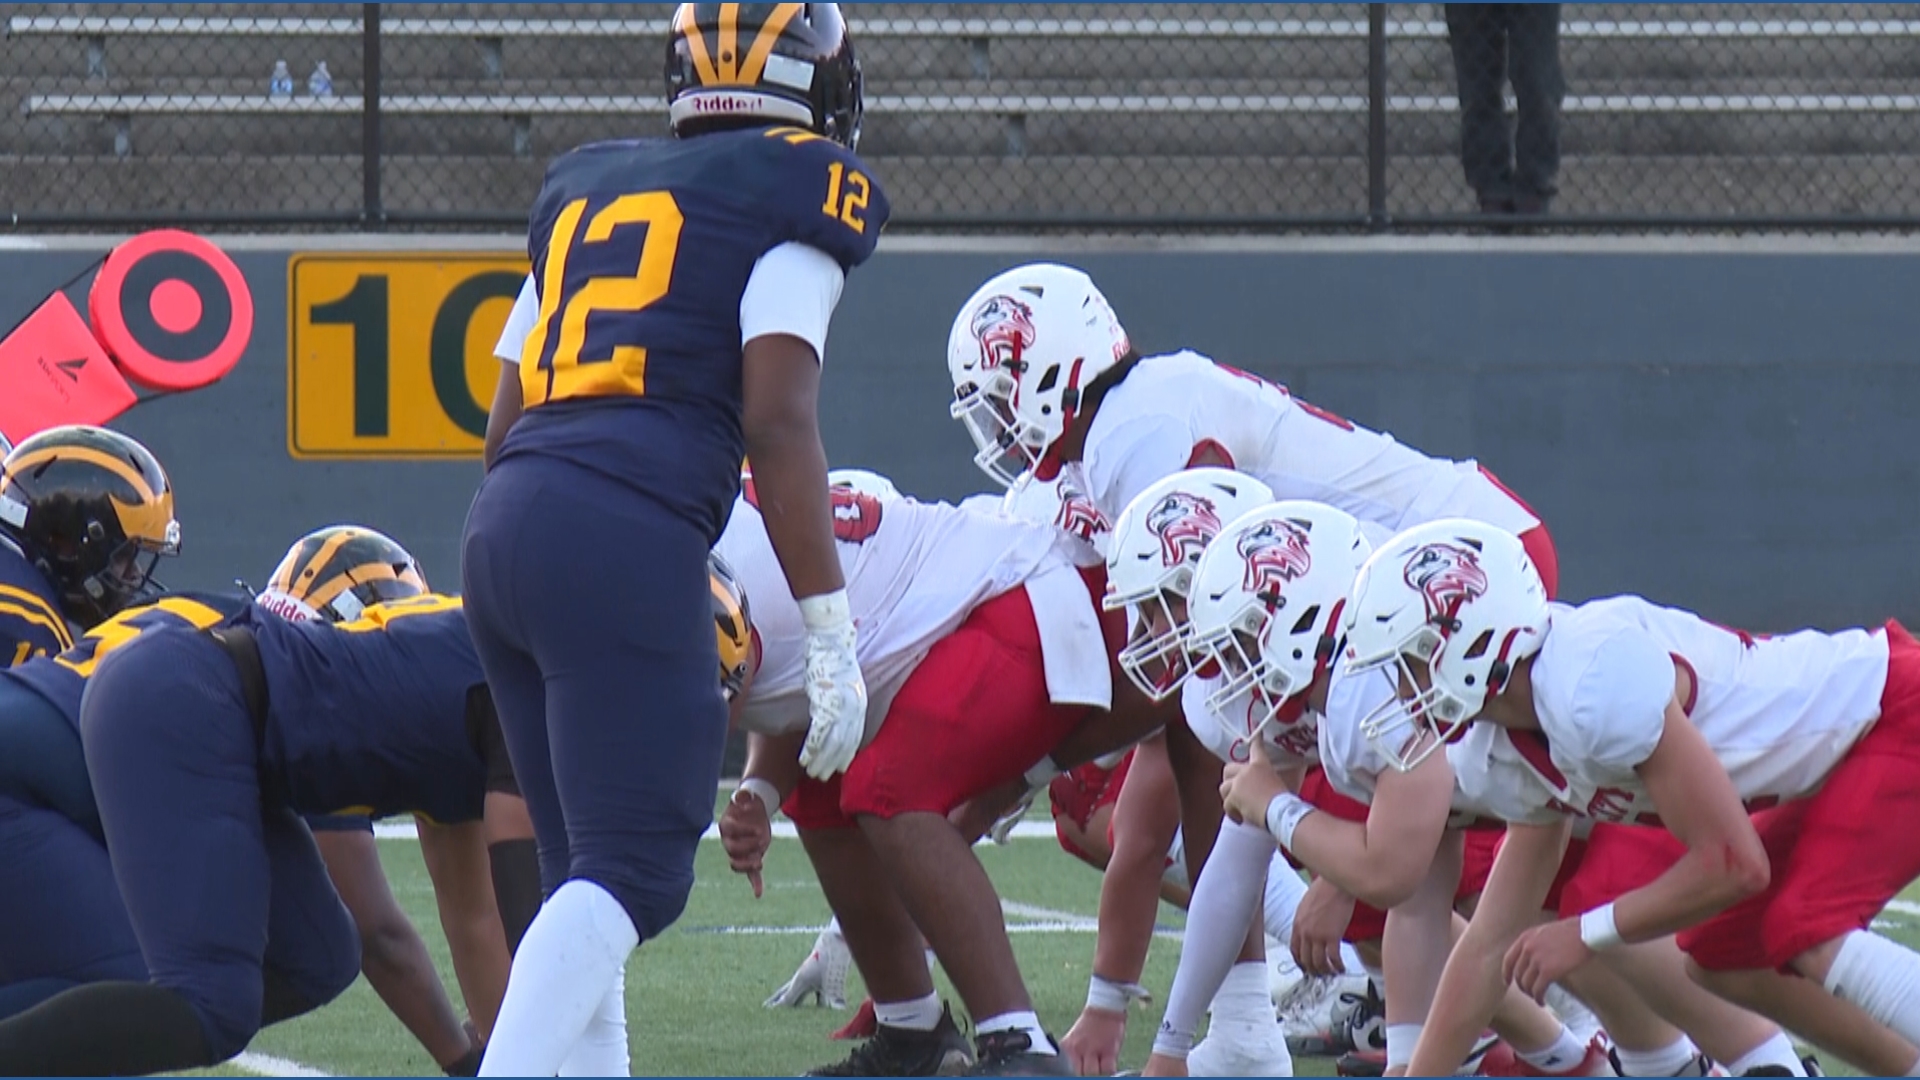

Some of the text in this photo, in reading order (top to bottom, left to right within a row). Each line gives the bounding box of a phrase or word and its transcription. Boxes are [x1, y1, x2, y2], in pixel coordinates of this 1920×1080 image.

[822, 161, 871, 235] 12
[520, 189, 686, 410] 12
[262, 593, 307, 622] Ridde
